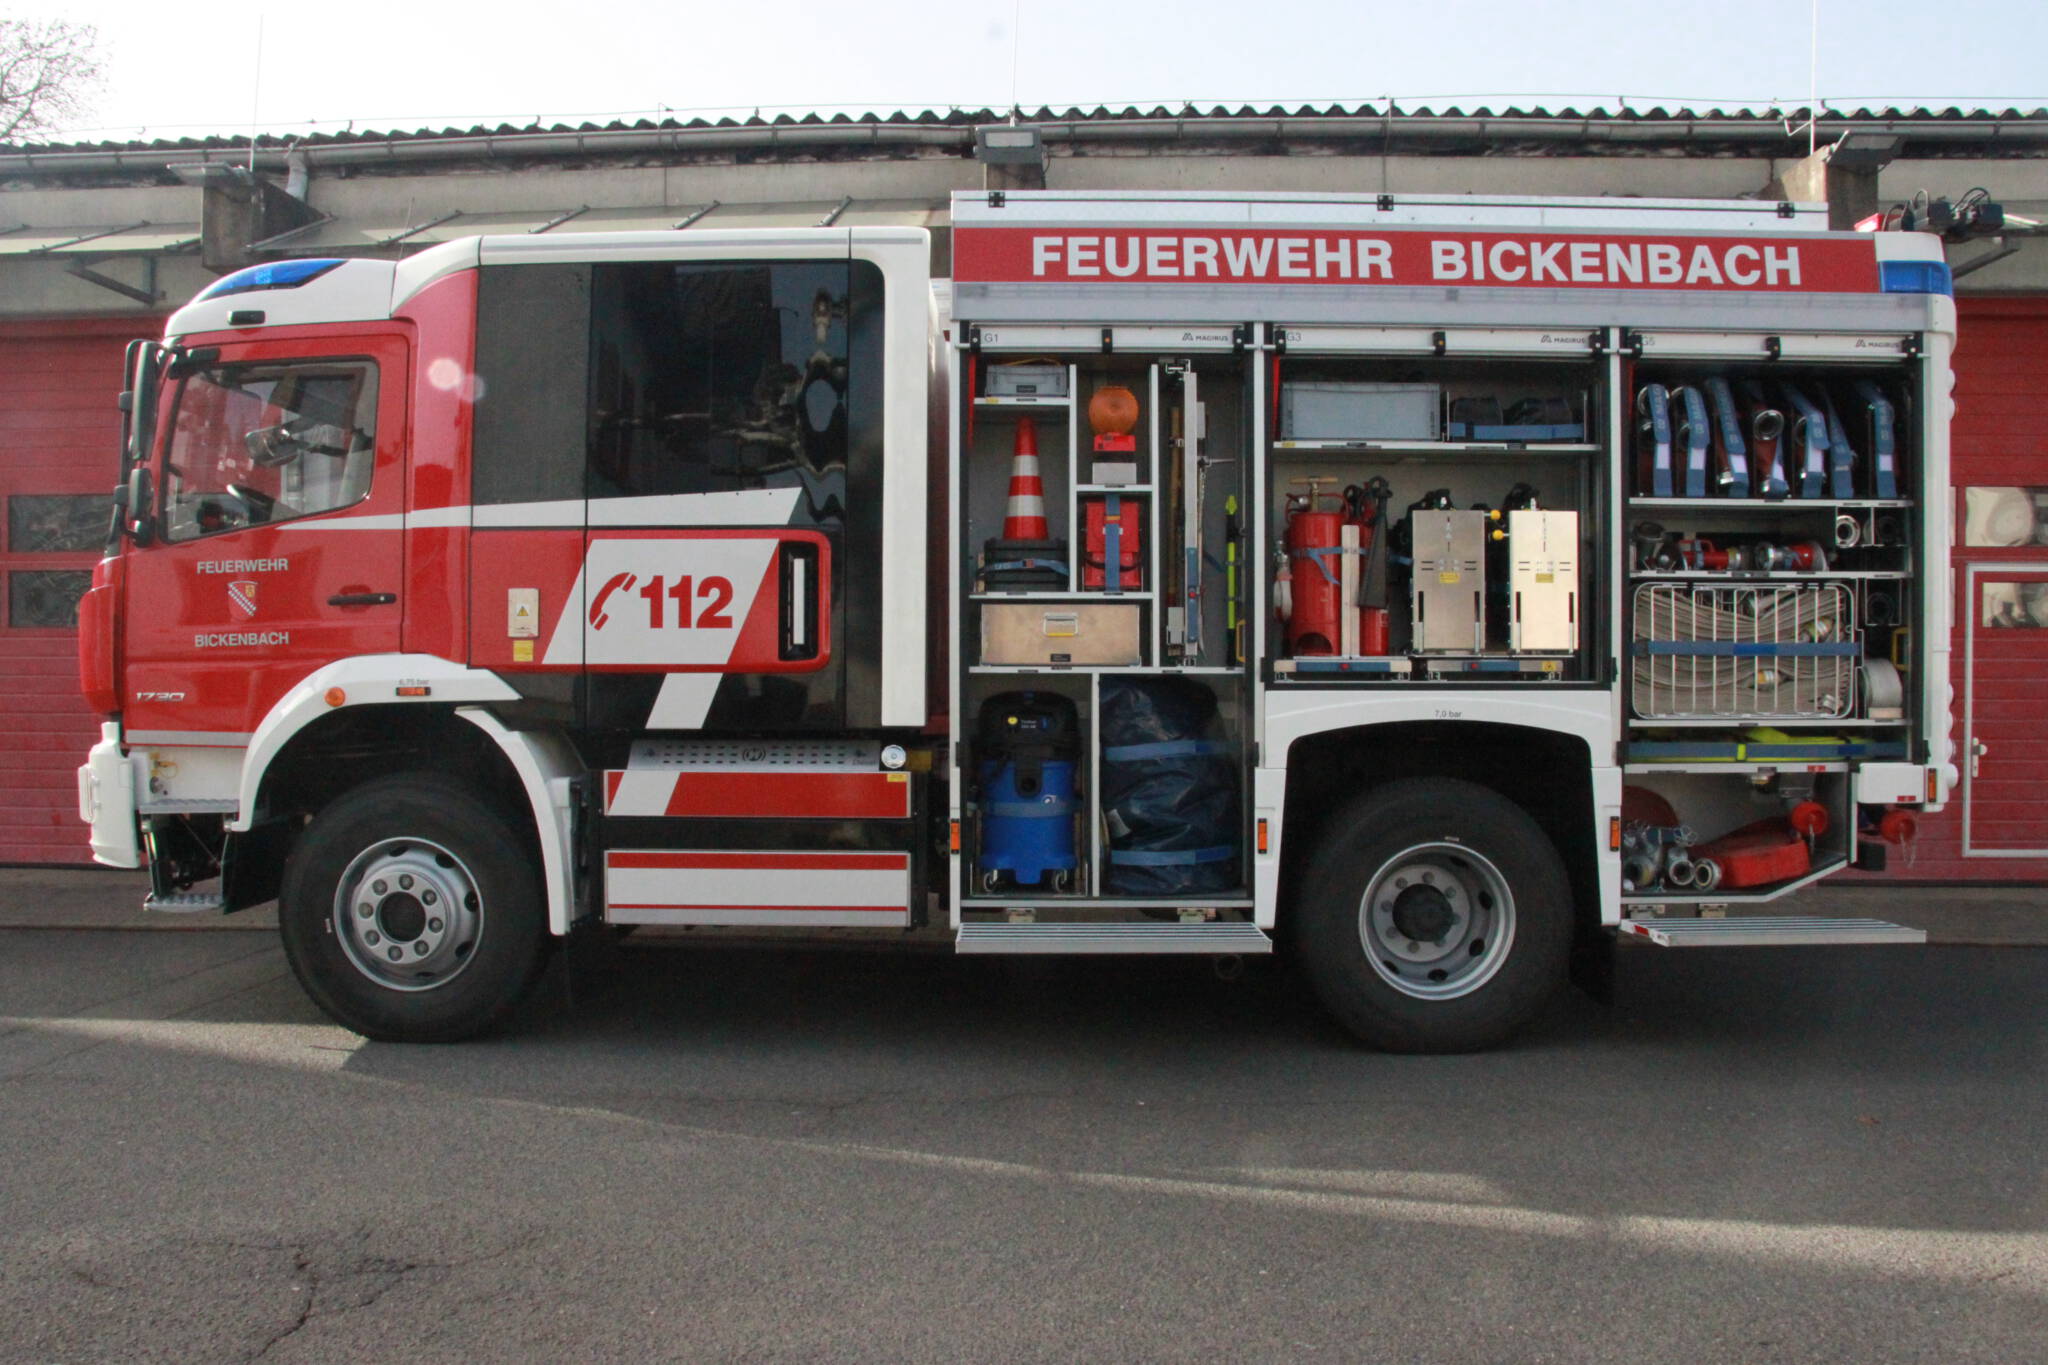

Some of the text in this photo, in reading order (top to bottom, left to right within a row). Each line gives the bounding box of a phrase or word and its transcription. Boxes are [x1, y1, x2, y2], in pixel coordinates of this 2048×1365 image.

[1032, 235, 1801, 286] FEUERWEHR BICKENBACH
[984, 332, 998, 344] G1
[196, 558, 289, 574] FEUERWEHR
[639, 574, 734, 629] 112
[194, 632, 290, 648] BICKENBACH
[135, 691, 186, 702] 1730
[1448, 710, 1462, 718] bar
